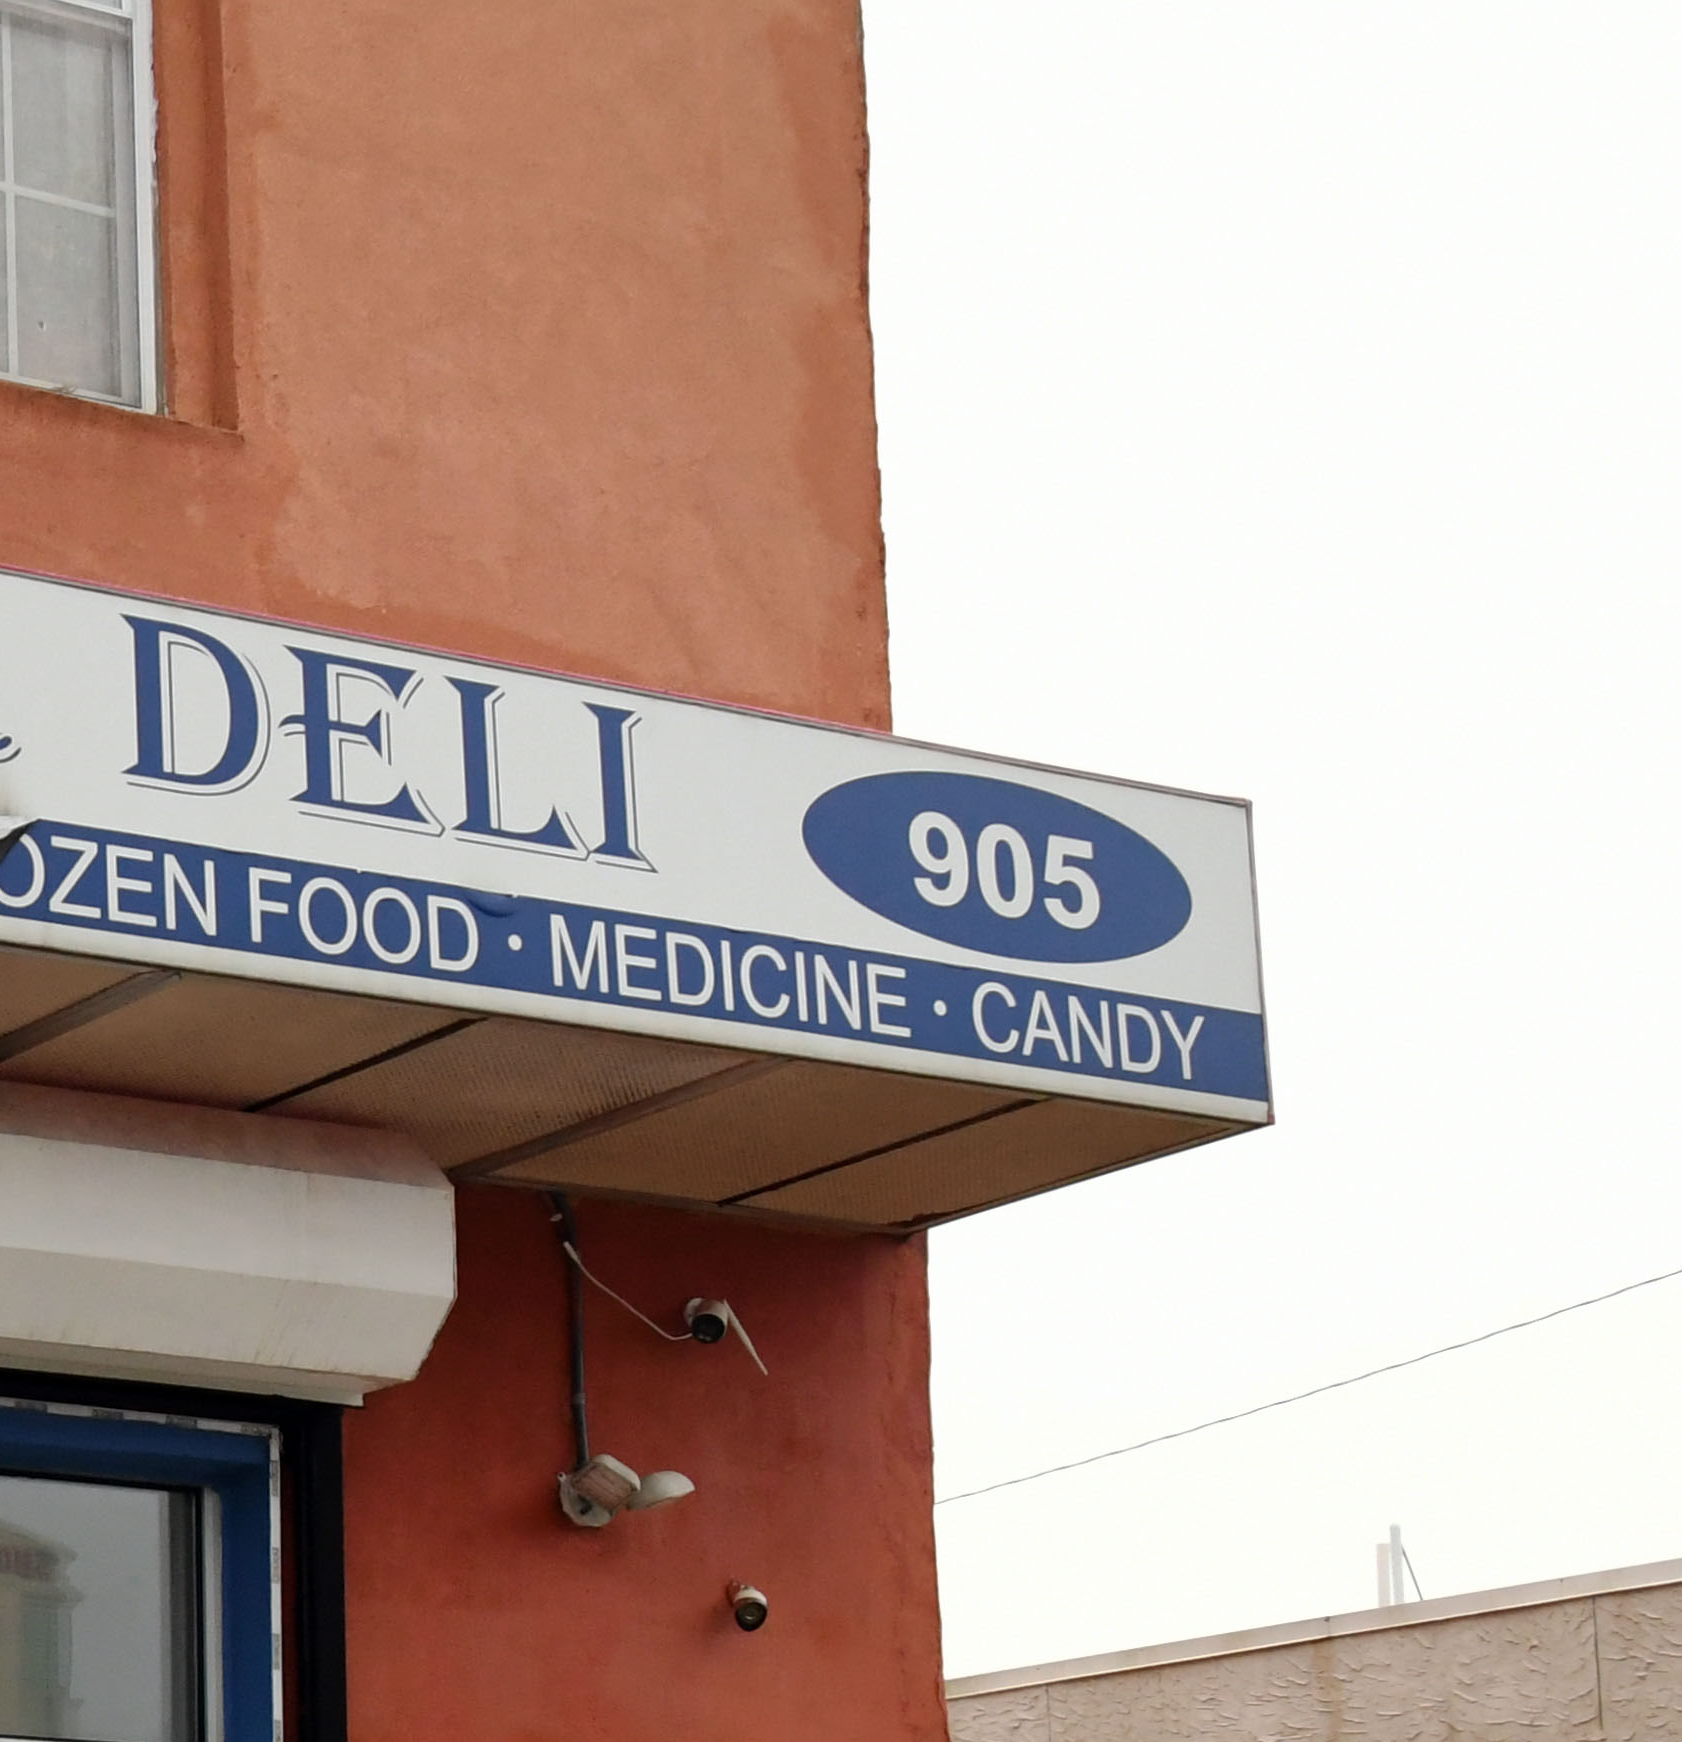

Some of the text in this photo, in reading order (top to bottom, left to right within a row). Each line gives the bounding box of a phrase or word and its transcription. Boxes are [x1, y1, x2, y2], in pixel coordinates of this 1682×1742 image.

[120, 613, 658, 874] DELI
[248, 867, 480, 973] FOOD
[551, 913, 912, 1038] MEDICINE
[971, 982, 1206, 1082] CANDY
[906, 810, 1101, 931] 905
